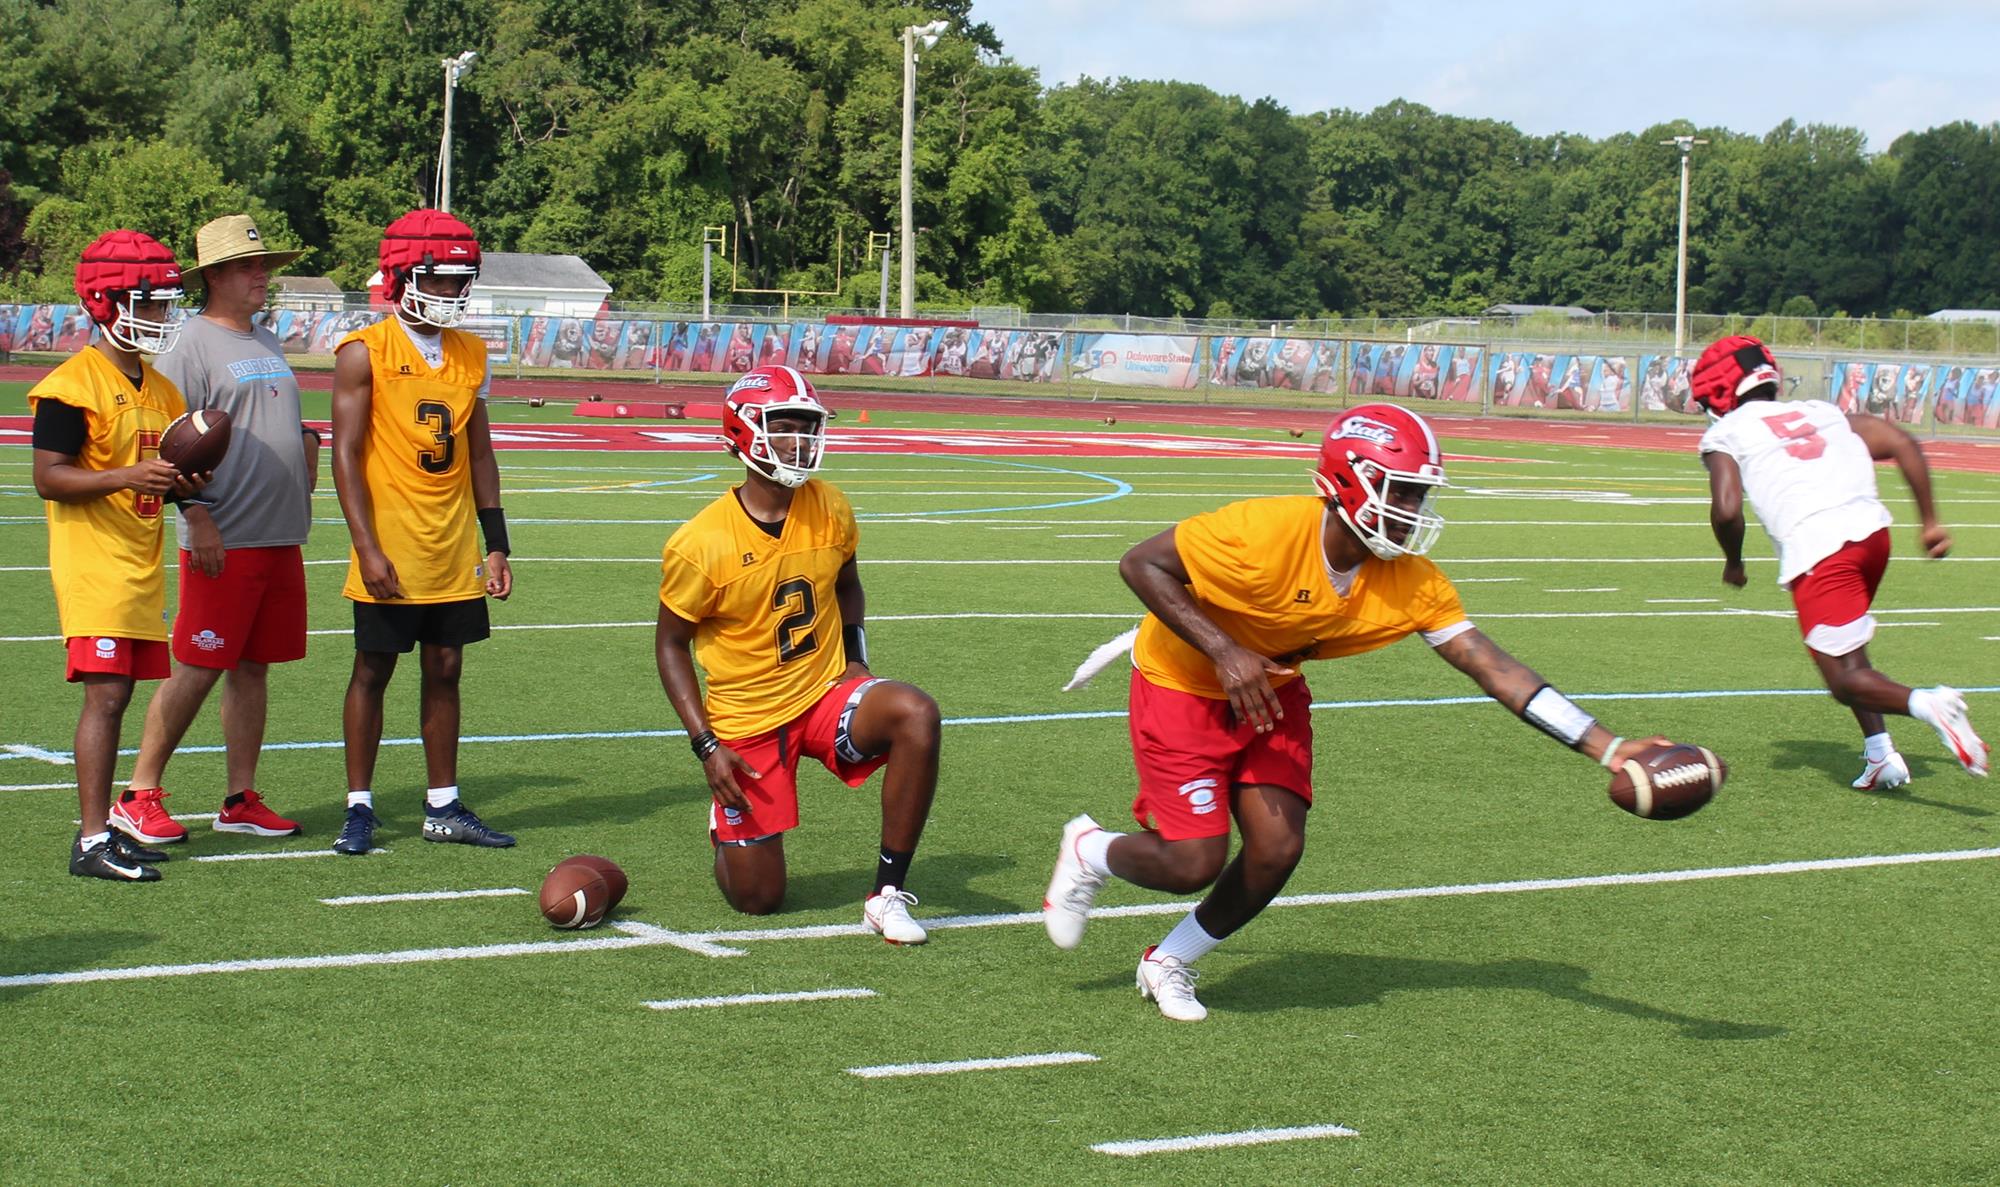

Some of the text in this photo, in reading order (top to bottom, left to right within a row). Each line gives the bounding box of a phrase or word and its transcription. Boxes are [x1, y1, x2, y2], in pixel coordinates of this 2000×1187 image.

[414, 399, 455, 475] 3
[1330, 415, 1395, 445] State
[1760, 411, 1827, 461] 5
[771, 574, 820, 667] 2
